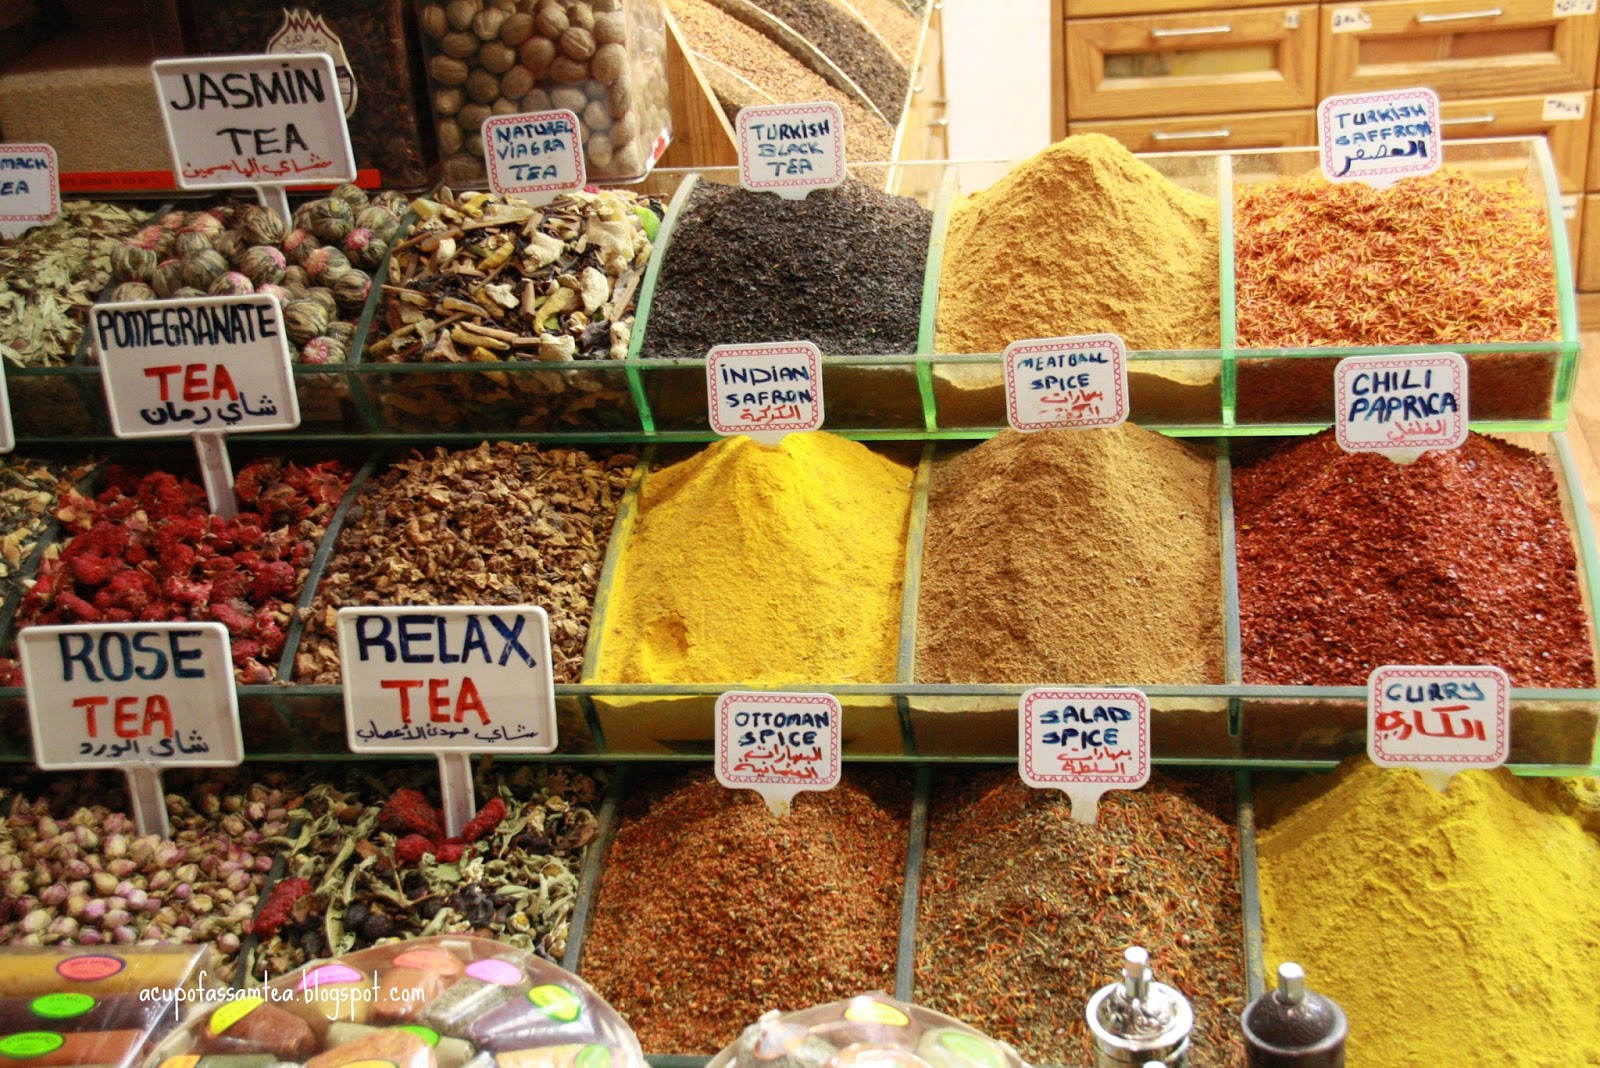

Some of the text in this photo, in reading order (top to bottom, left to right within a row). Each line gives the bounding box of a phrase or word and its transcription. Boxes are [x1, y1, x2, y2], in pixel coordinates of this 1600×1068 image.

[216, 123, 309, 156] TEA
[1335, 121, 1432, 145] SAFFRON
[758, 142, 824, 157] BLACK
[509, 164, 557, 181] TEA
[767, 158, 813, 177] TEA
[0, 180, 30, 196] EA
[96, 303, 277, 350] POMEGRANATE
[144, 363, 239, 402] TEA
[1030, 373, 1090, 391] SPICE
[1351, 369, 1432, 396] CHILI
[726, 389, 813, 408] SAFRON
[356, 614, 537, 668] RELAX
[58, 630, 206, 682] ROSE
[380, 676, 492, 726] TEA
[1385, 682, 1485, 703] CURRY
[72, 694, 175, 739] TEA
[735, 711, 829, 729] OTTOMAN
[1039, 705, 1132, 725] SALAD
[738, 729, 818, 747] SPICE
[1041, 728, 1119, 749] SPICE
